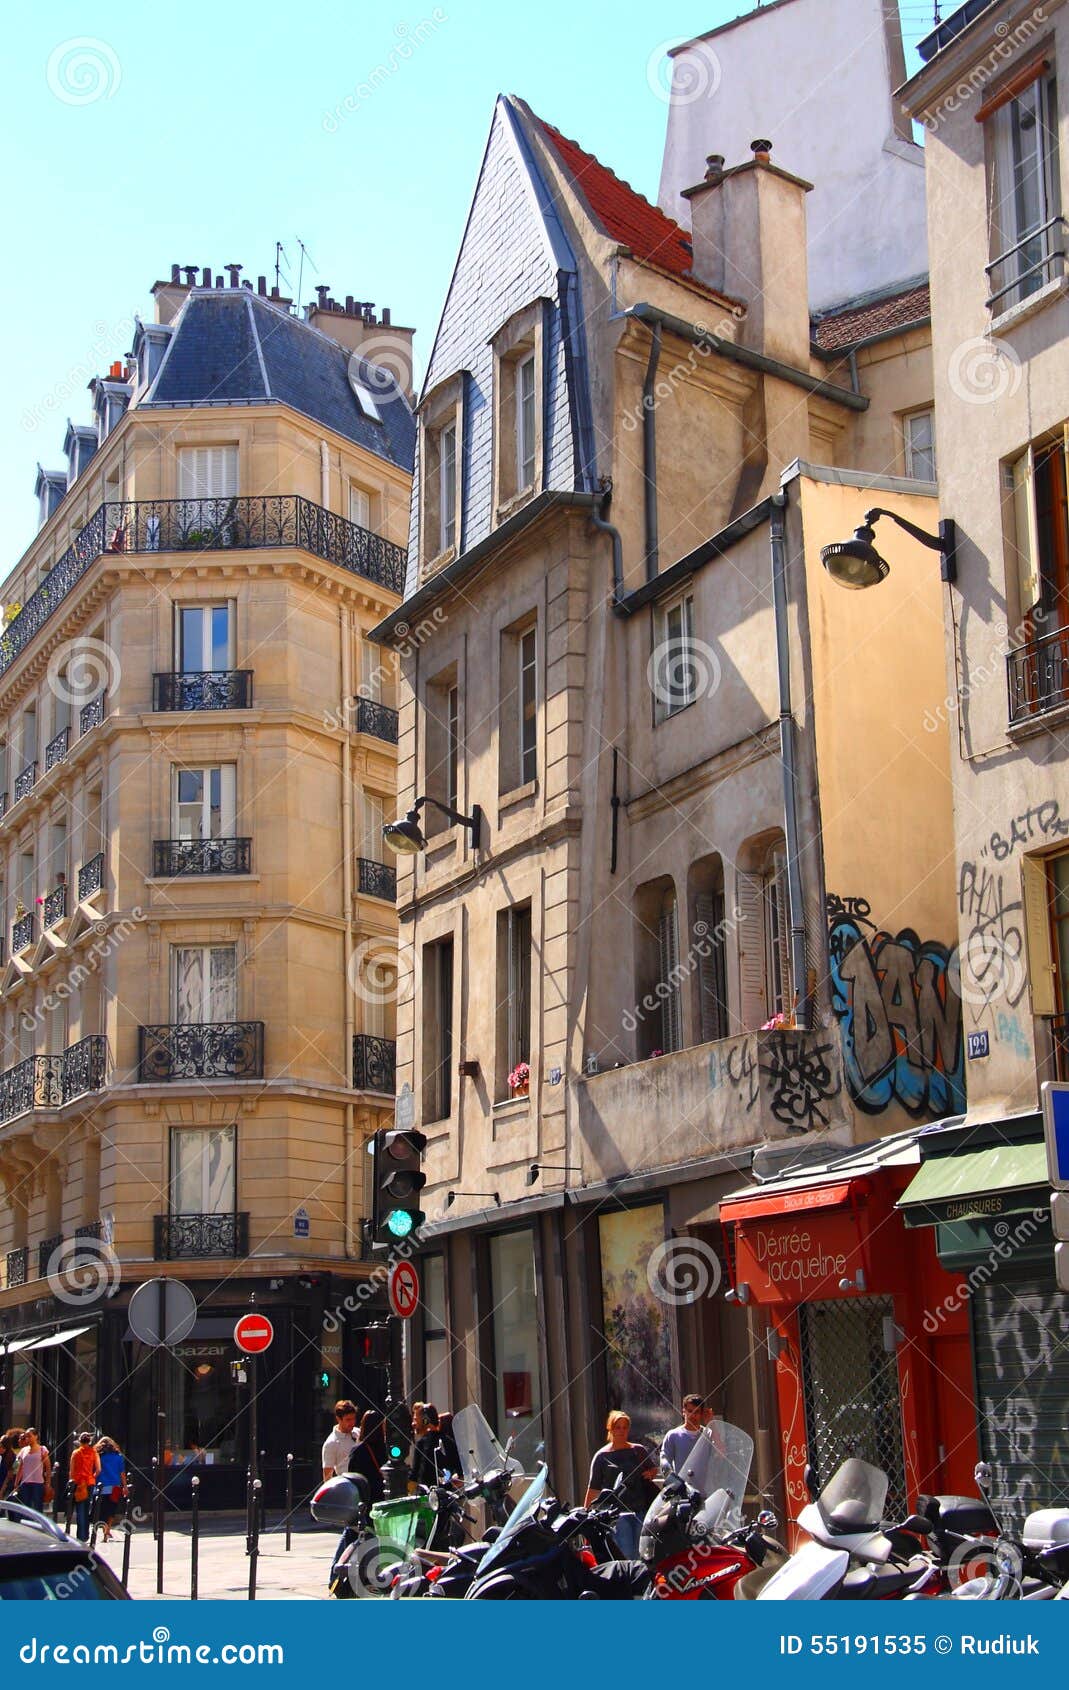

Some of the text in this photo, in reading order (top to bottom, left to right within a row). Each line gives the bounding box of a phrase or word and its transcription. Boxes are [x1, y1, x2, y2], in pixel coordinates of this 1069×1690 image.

[968, 1034, 988, 1058] 129
[946, 1199, 1002, 1218] CHAUSSURES
[757, 1226, 811, 1262] Désirée
[171, 1345, 230, 1357] bazar
